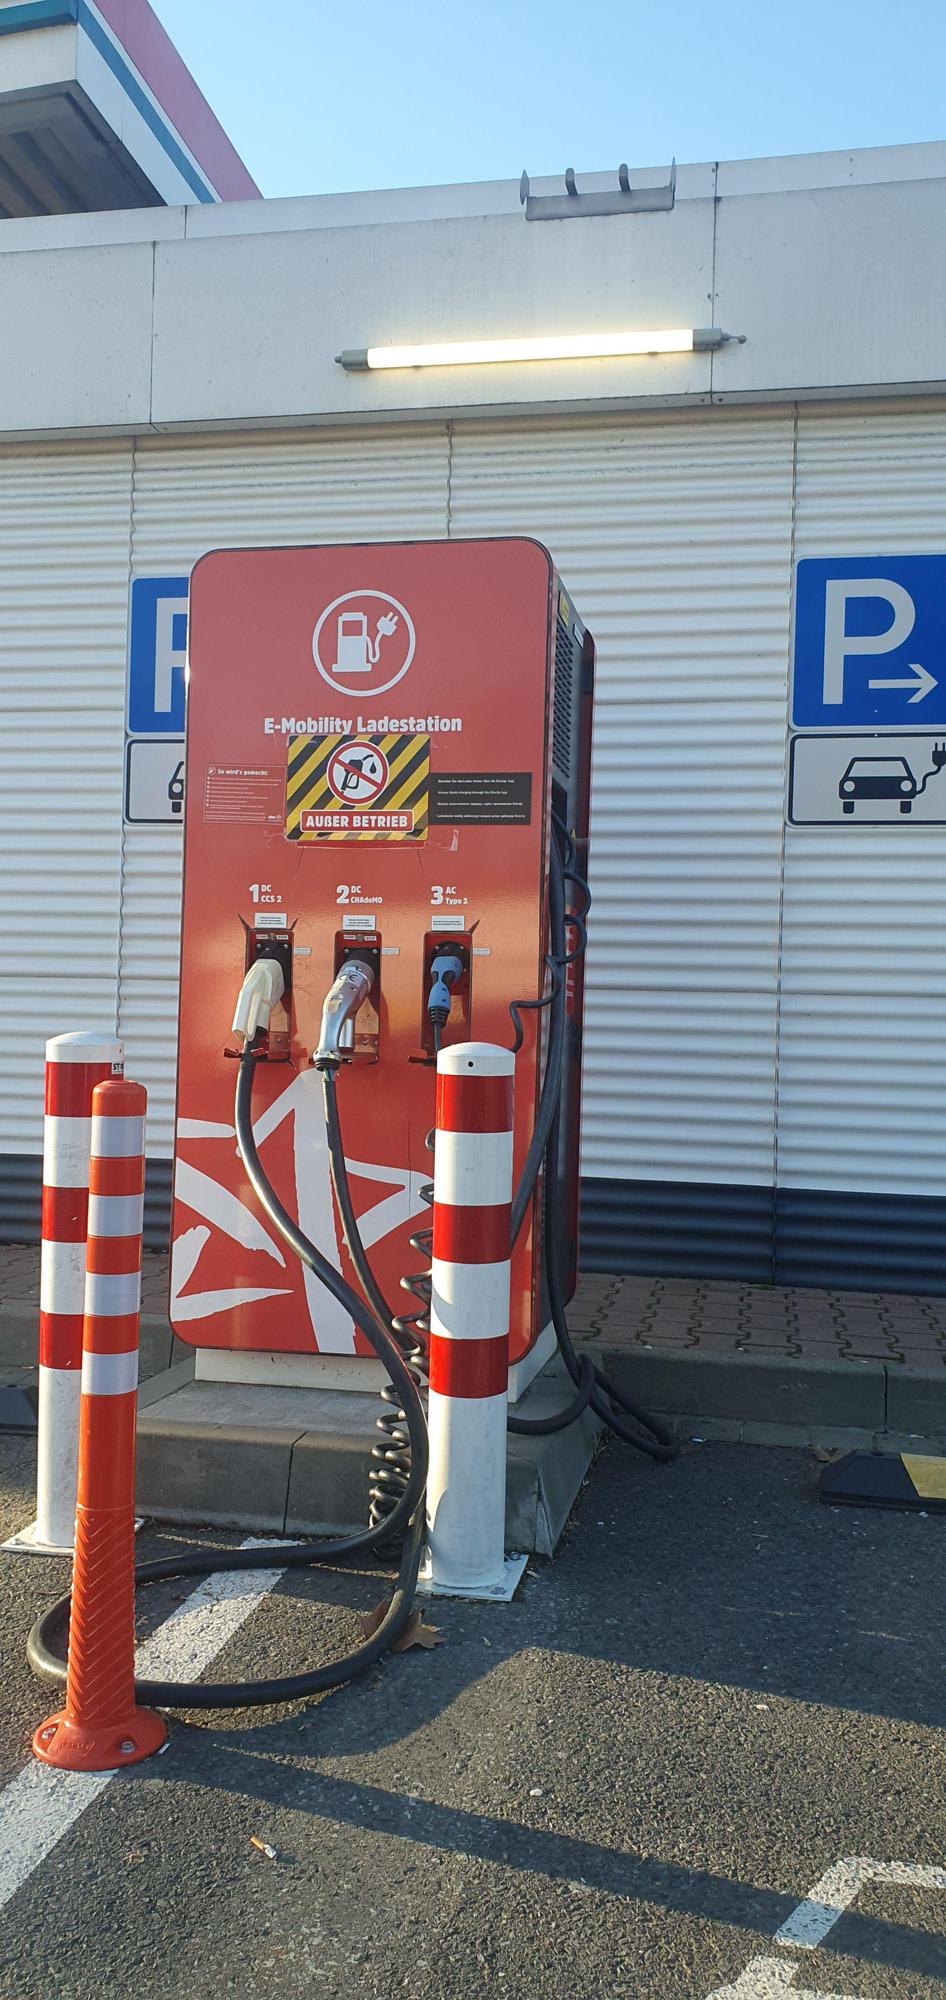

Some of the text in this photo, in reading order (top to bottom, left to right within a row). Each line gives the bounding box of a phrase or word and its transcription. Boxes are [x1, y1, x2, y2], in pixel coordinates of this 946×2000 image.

[822, 578, 916, 705] P
[264, 716, 462, 736] E-Mobility Ladestation
[306, 814, 408, 828] AUßER BETRIEB
[249, 884, 259, 903] 1
[261, 895, 282, 903] CCS 2
[336, 885, 349, 904] 2
[430, 886, 444, 905] 3
[445, 886, 457, 894] AC
[445, 897, 468, 906] Type 2
